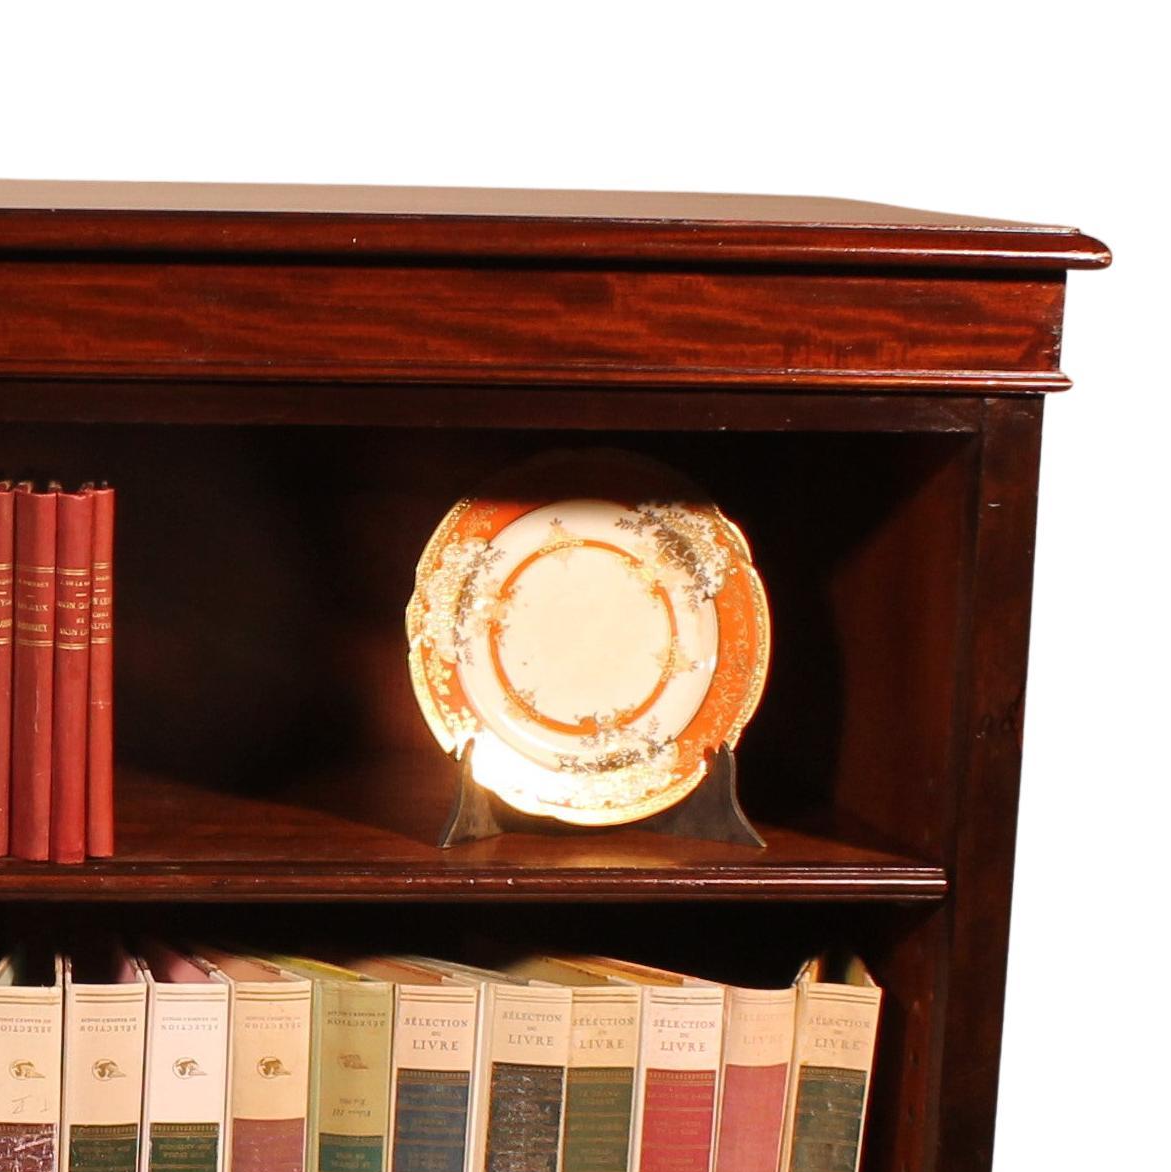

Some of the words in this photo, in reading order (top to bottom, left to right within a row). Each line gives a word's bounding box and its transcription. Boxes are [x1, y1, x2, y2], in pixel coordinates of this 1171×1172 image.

[412, 1040, 459, 1051] LIVRE
[508, 1034, 554, 1046] LIVRE
[580, 1039, 625, 1049] LIVRE
[814, 1038, 860, 1050] LIVRE
[660, 1041, 707, 1052] LIVRE
